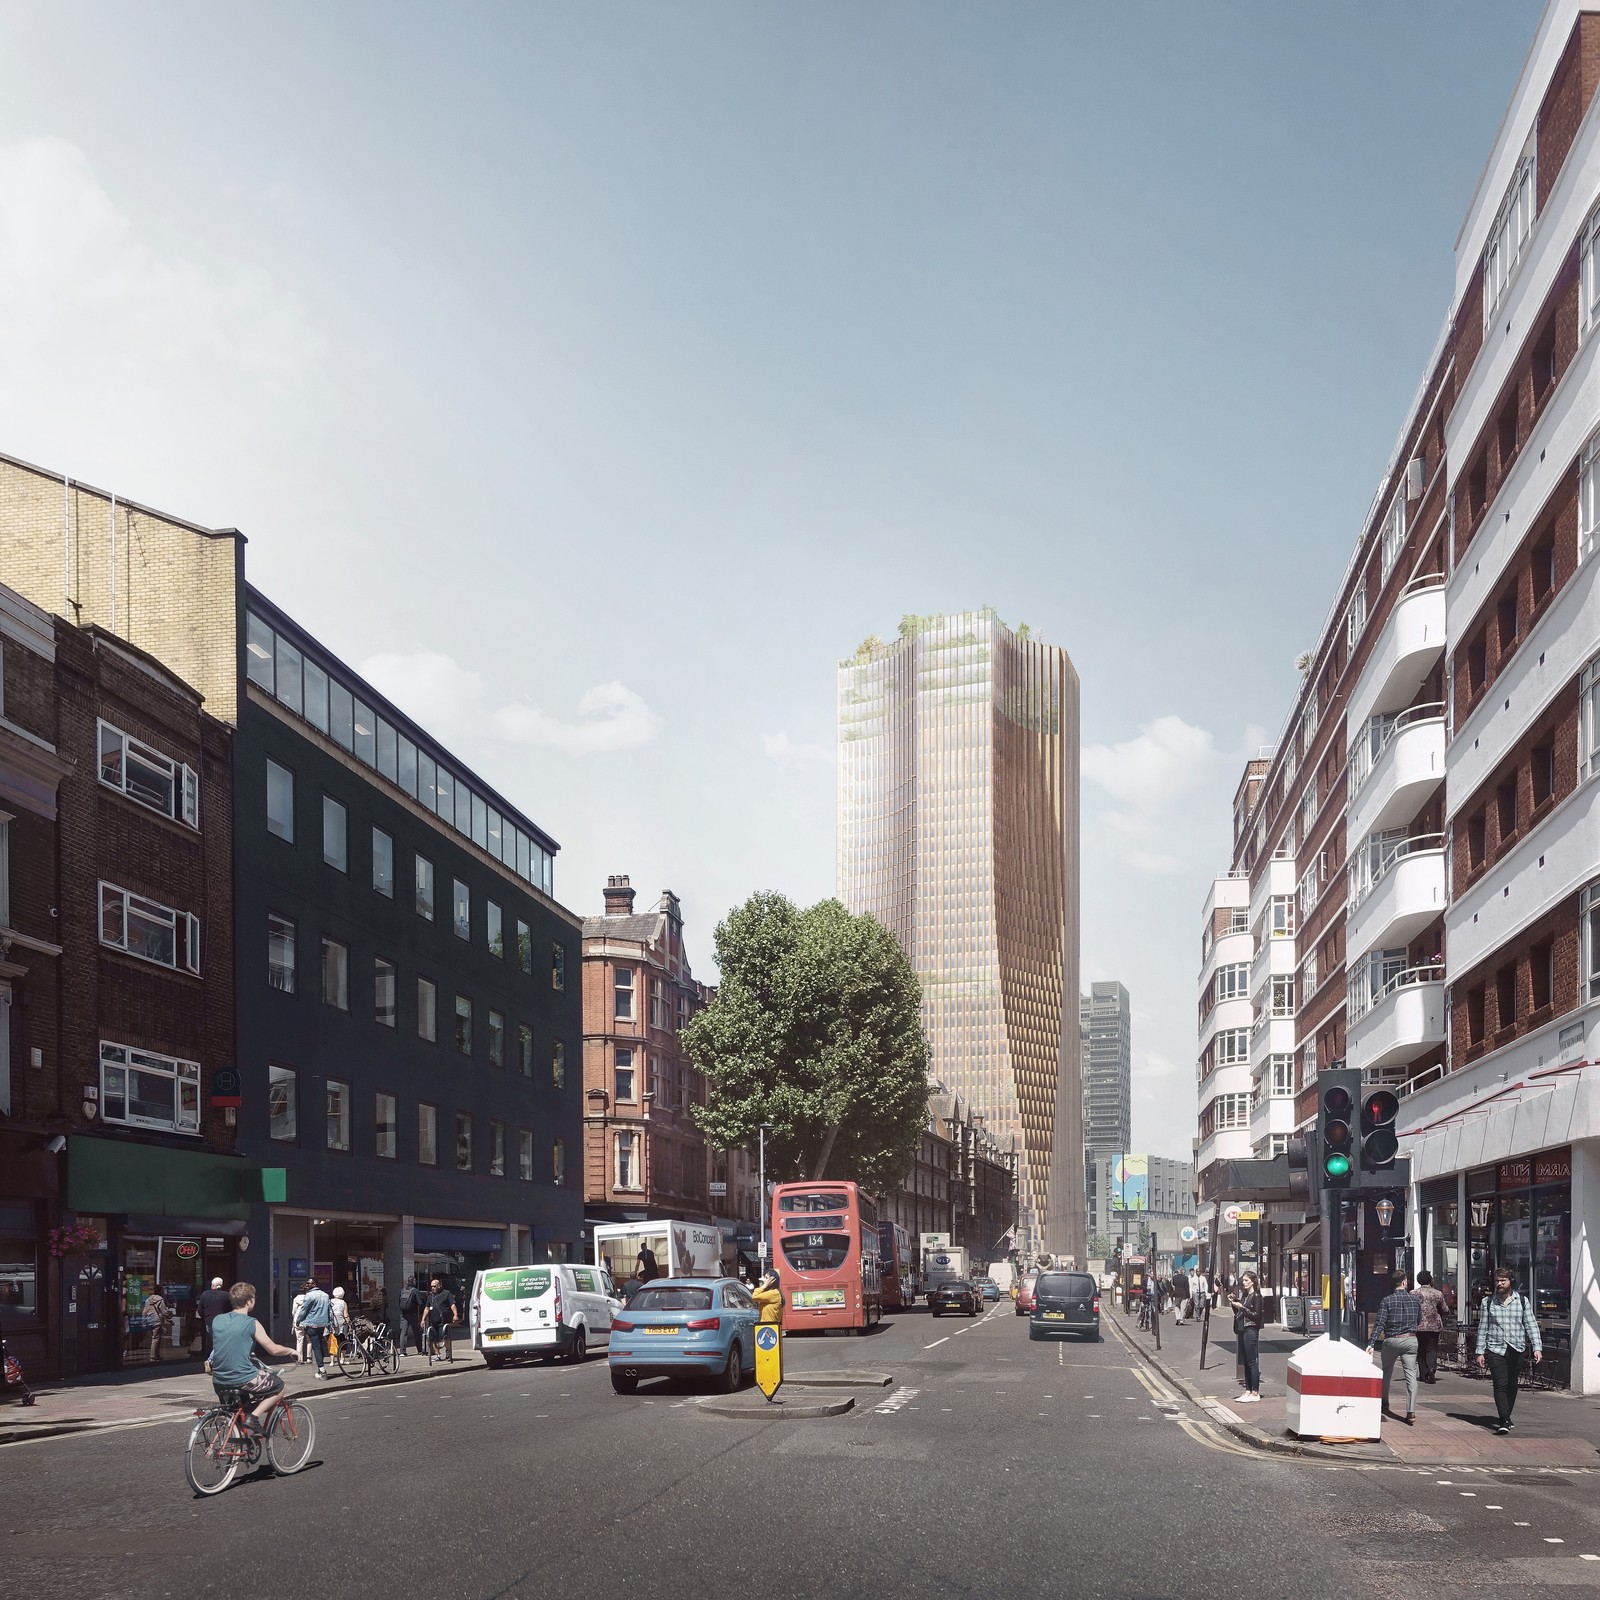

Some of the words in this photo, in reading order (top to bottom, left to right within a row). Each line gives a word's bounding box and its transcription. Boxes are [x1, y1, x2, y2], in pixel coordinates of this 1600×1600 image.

[109, 1075, 117, 1087] e
[809, 1235, 823, 1246] 134
[179, 1245, 196, 1254] OPEN
[485, 1280, 513, 1288] Europcar
